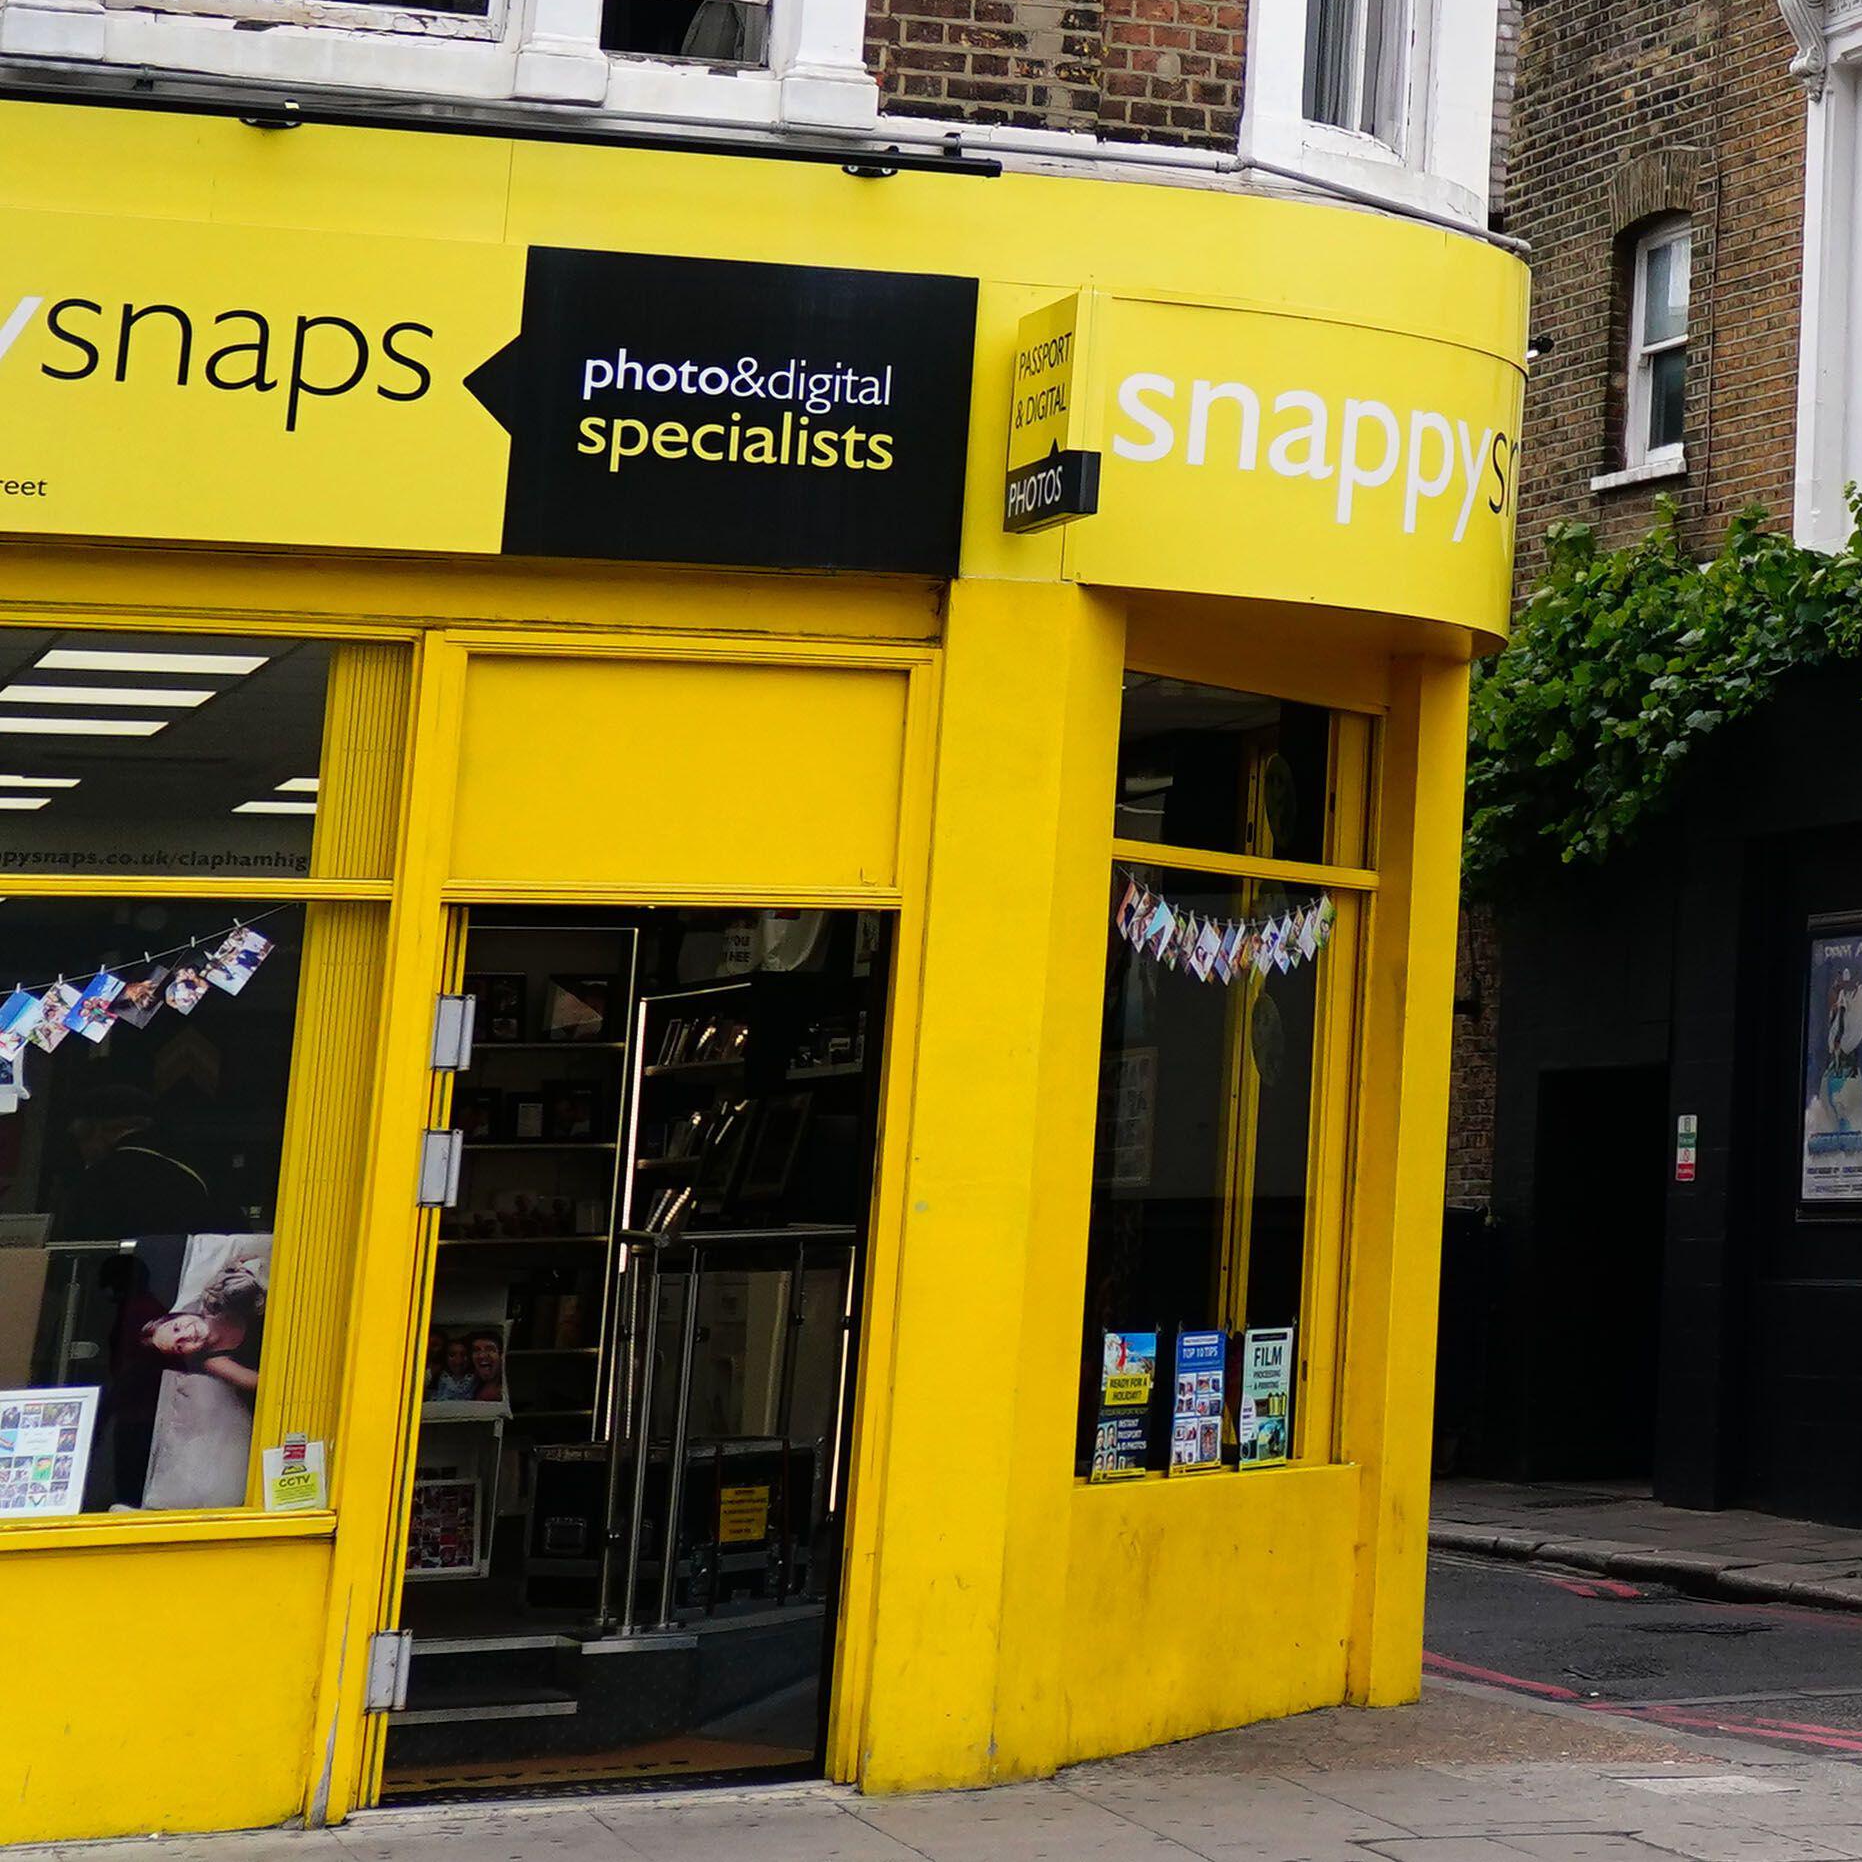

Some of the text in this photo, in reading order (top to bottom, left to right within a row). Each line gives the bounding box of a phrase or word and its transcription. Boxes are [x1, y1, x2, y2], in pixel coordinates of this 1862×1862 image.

[1018, 332, 1072, 381] PASSPORT
[583, 348, 892, 414] photo&digital
[1015, 382, 1068, 430] & DIGITAL
[577, 412, 894, 473] specialists
[1008, 465, 1063, 518] PHOTOS
[1254, 1346, 1282, 1367] FILM
[1110, 1378, 1129, 1388] READY
[1131, 1377, 1142, 1387] FOR
[279, 1474, 311, 1487] CCTV
